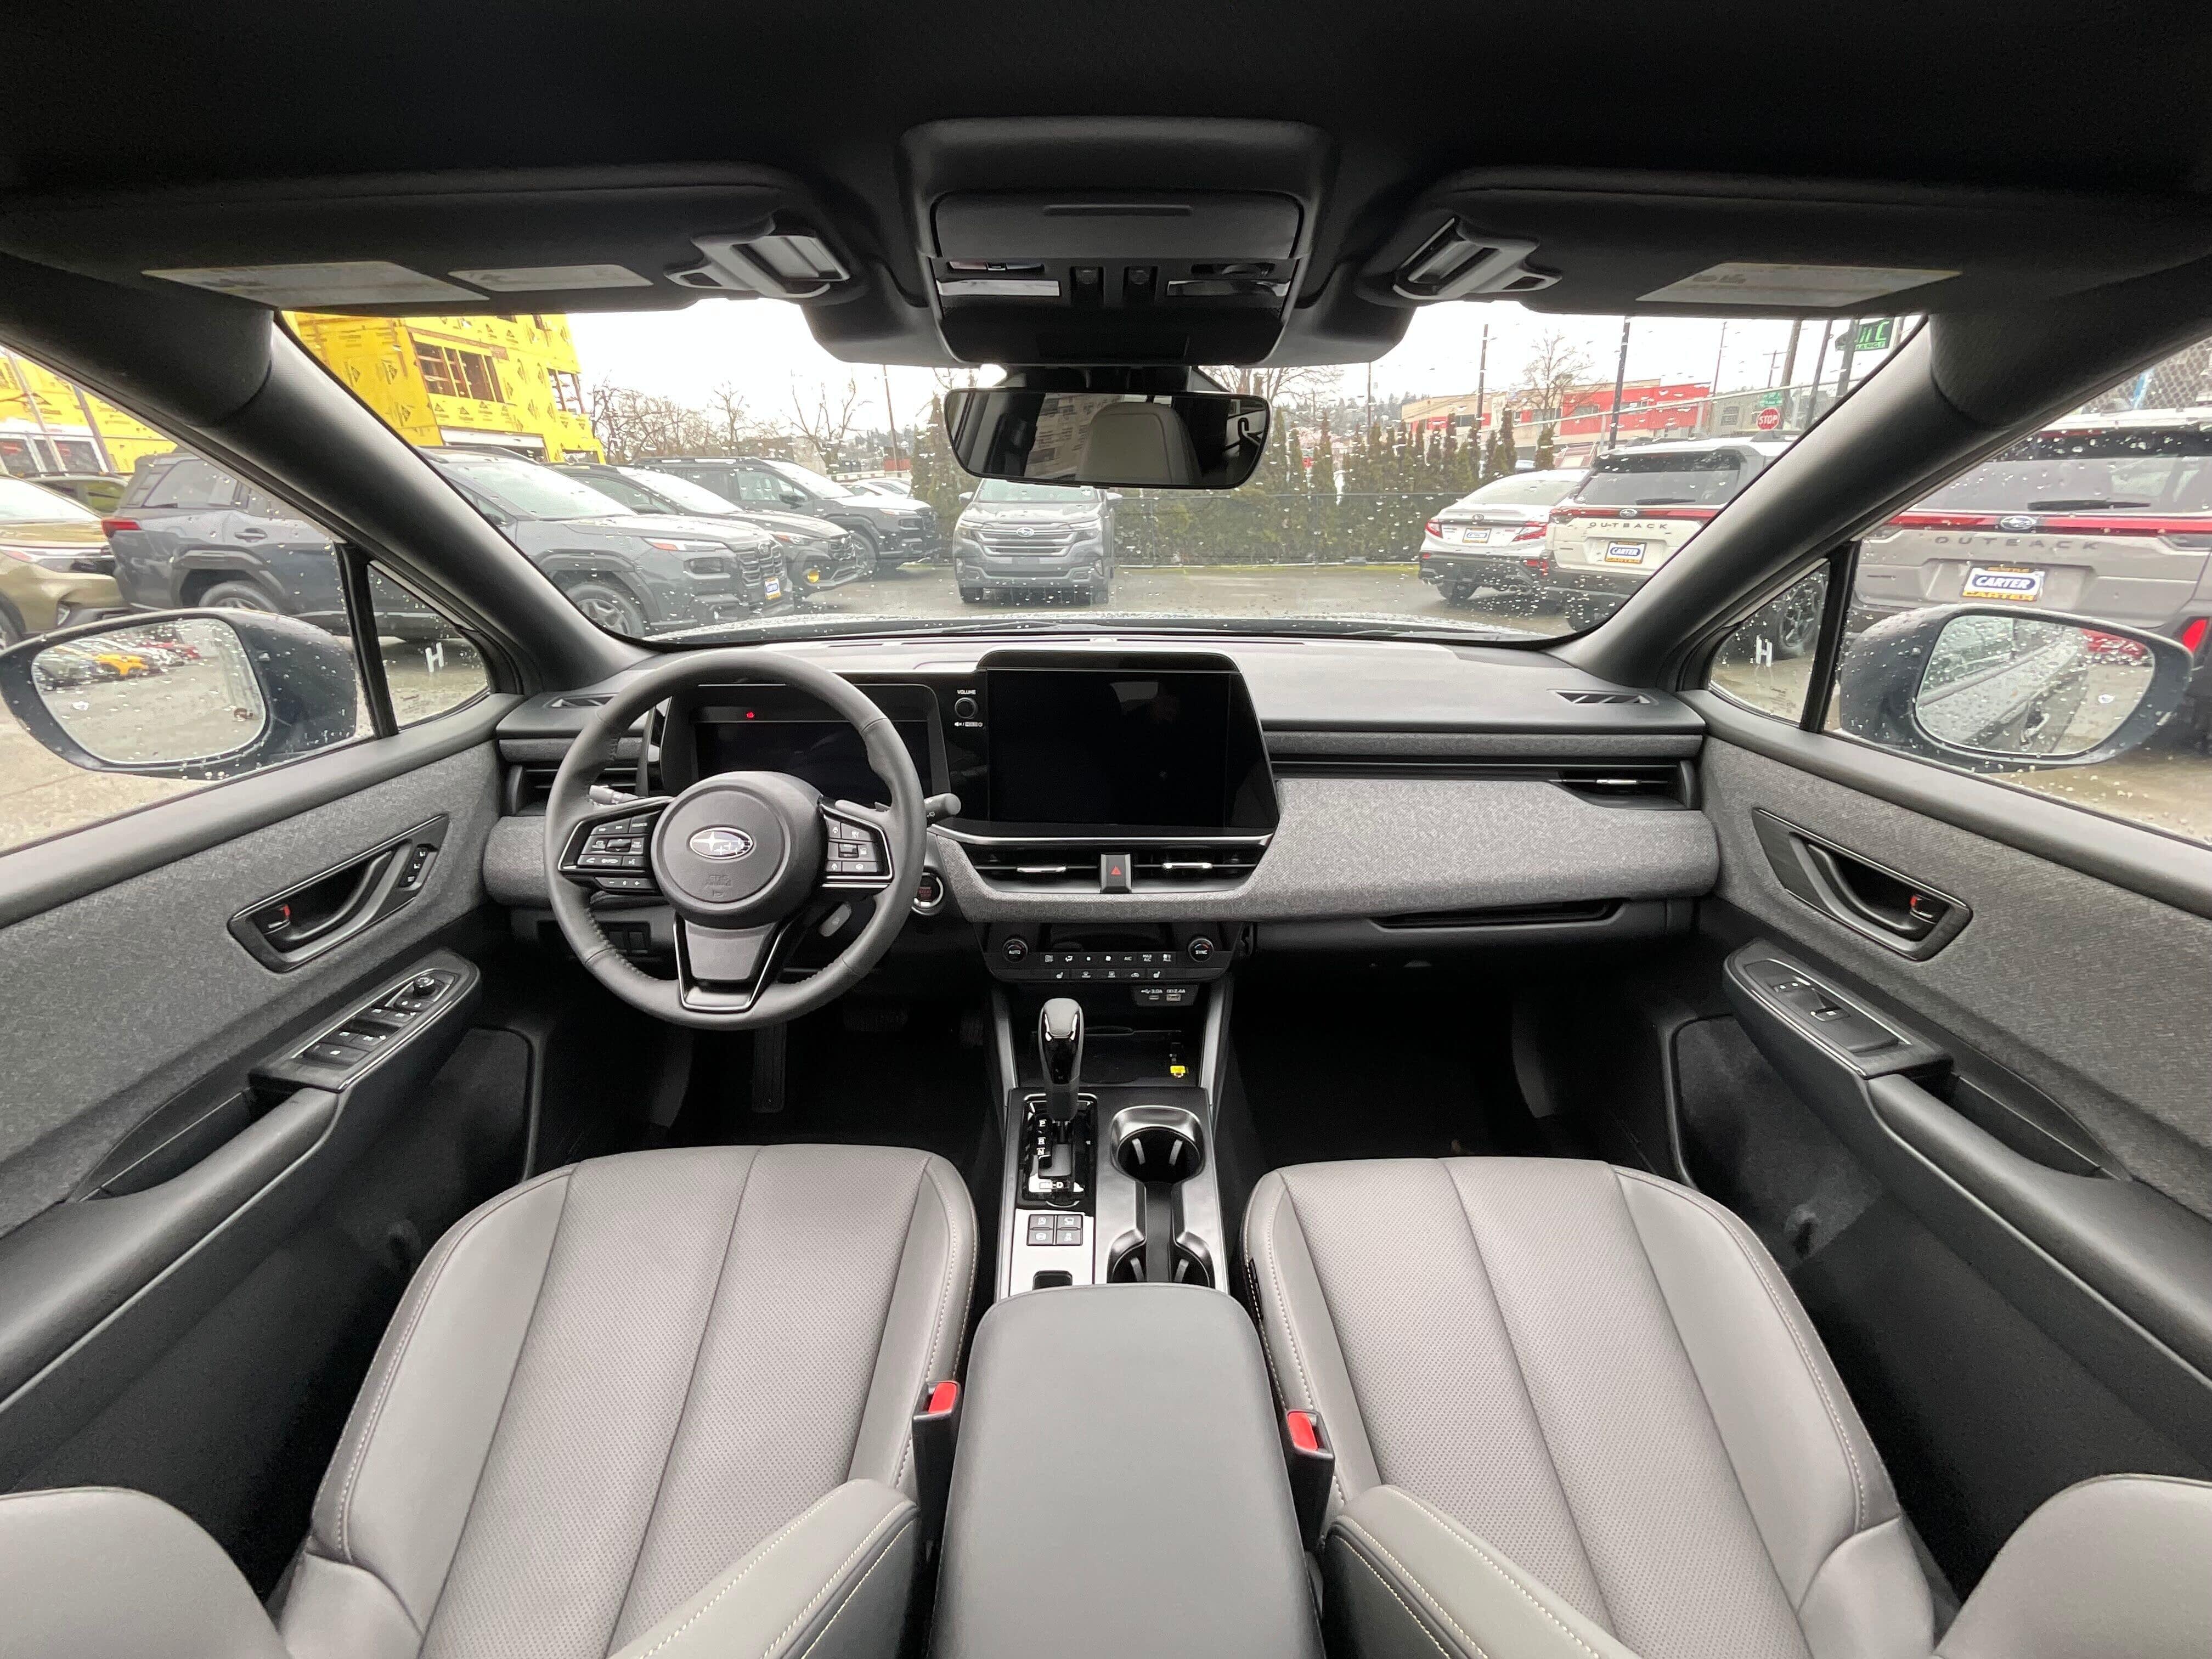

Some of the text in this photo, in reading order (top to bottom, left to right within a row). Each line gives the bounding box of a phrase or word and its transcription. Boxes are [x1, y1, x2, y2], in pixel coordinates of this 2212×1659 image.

[1758, 415, 1778, 425] STOP
[1934, 536, 2103, 550] OUTBACK
[1611, 547, 1639, 556] CARTER
[1976, 577, 2031, 589] CARTER
[1963, 591, 2035, 601] CARTER
[425, 642, 444, 673] H
[1756, 635, 1773, 668] H
